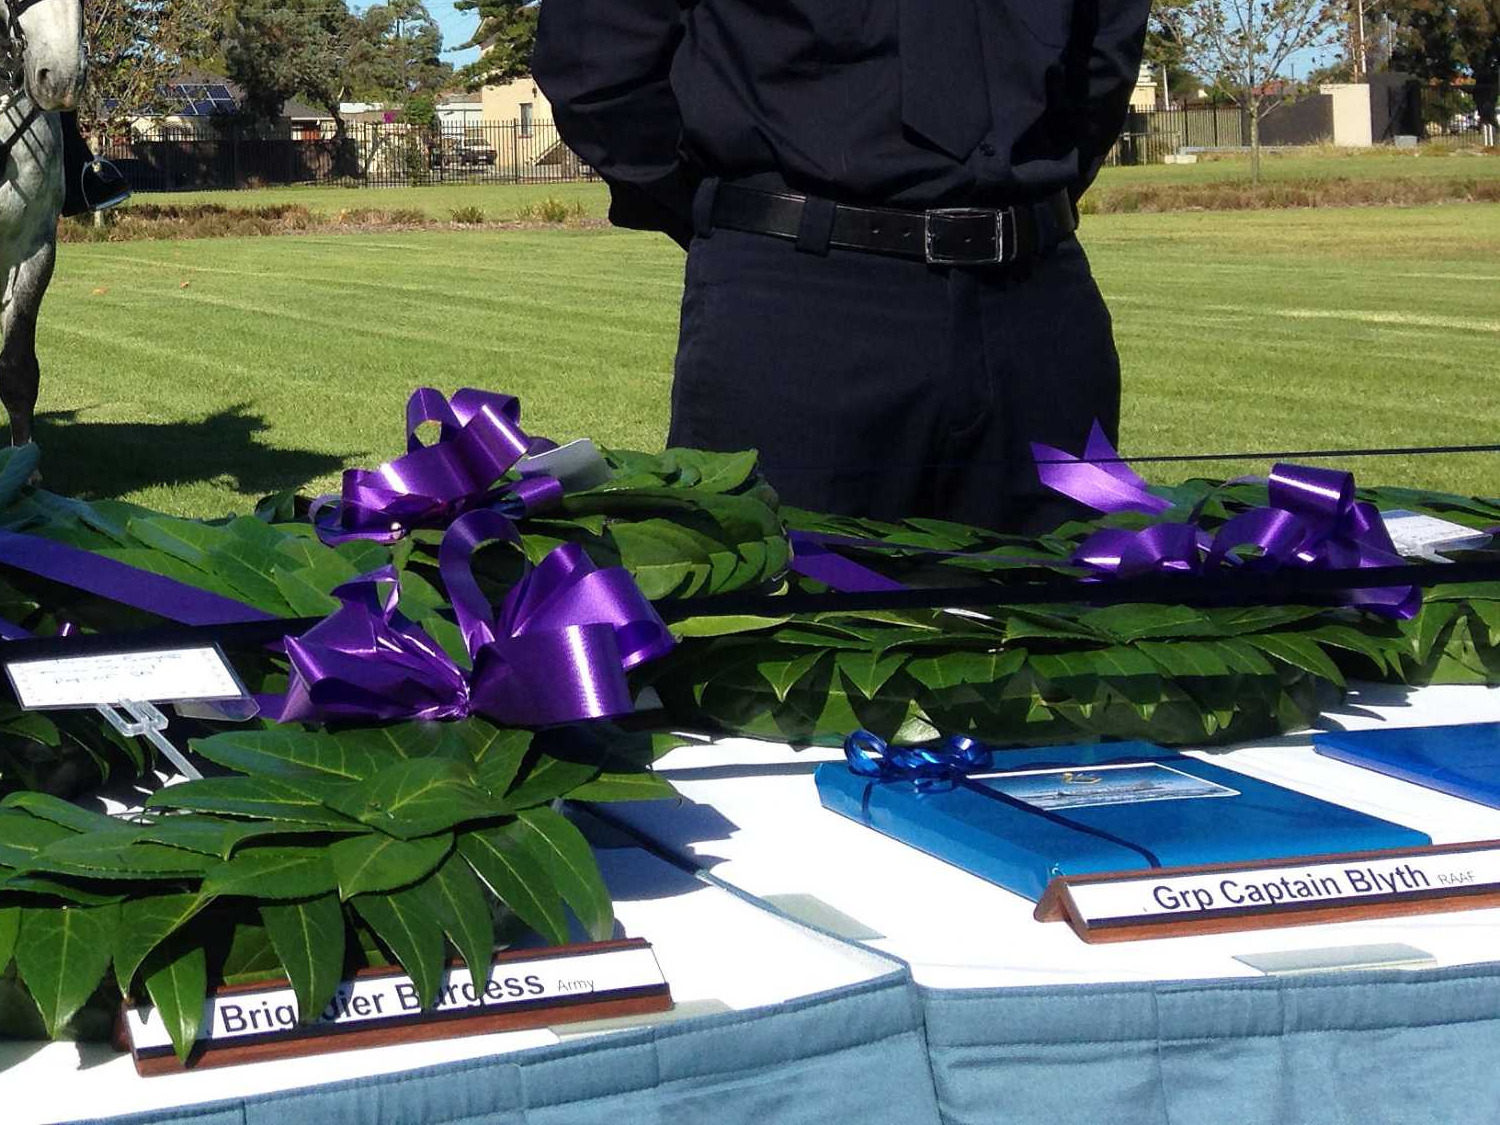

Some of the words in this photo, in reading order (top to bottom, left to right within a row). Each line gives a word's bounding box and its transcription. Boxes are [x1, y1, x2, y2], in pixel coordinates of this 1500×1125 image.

[1152, 884, 1214, 911] Grp
[1219, 872, 1343, 905] Captain
[1344, 864, 1431, 894] Blyth
[1437, 870, 1477, 885] RAAF
[220, 987, 385, 1033] Brigdier
[557, 978, 595, 994] Army
